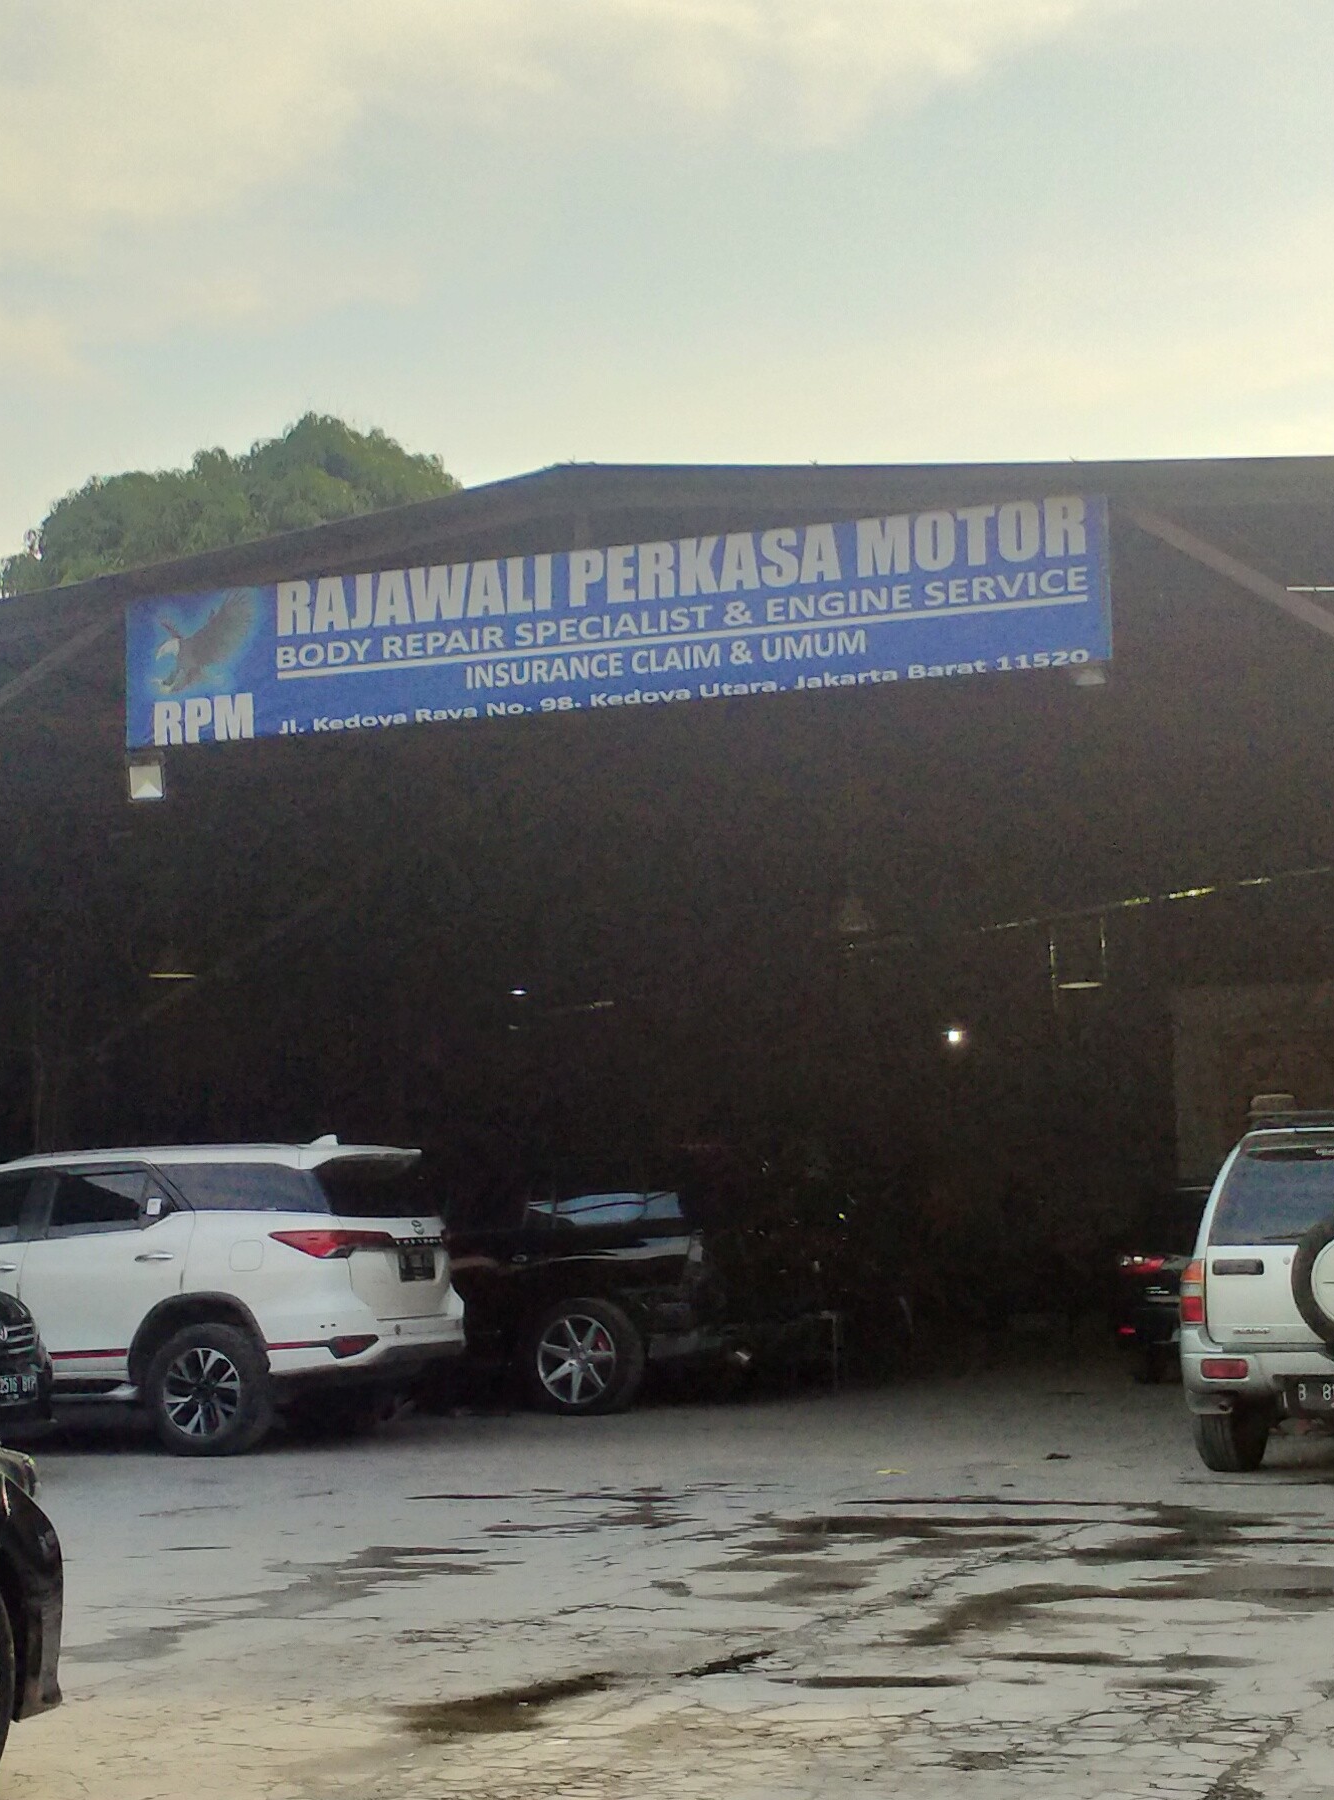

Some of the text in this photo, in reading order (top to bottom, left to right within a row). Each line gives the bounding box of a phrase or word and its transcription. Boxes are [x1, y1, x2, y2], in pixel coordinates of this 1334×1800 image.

[277, 495, 1087, 636] RAJAWALI PERKASA MOTOR
[277, 566, 1089, 671] BODY REPAIR SPECIALIST & ENGINE SERVICE
[466, 629, 867, 690] INSURANCE CLAIM & UMUM
[486, 701, 533, 717] No.
[793, 668, 898, 691] Jakarta
[907, 659, 988, 680] Barat
[996, 649, 1090, 672] 11520
[153, 692, 255, 747] RPM
